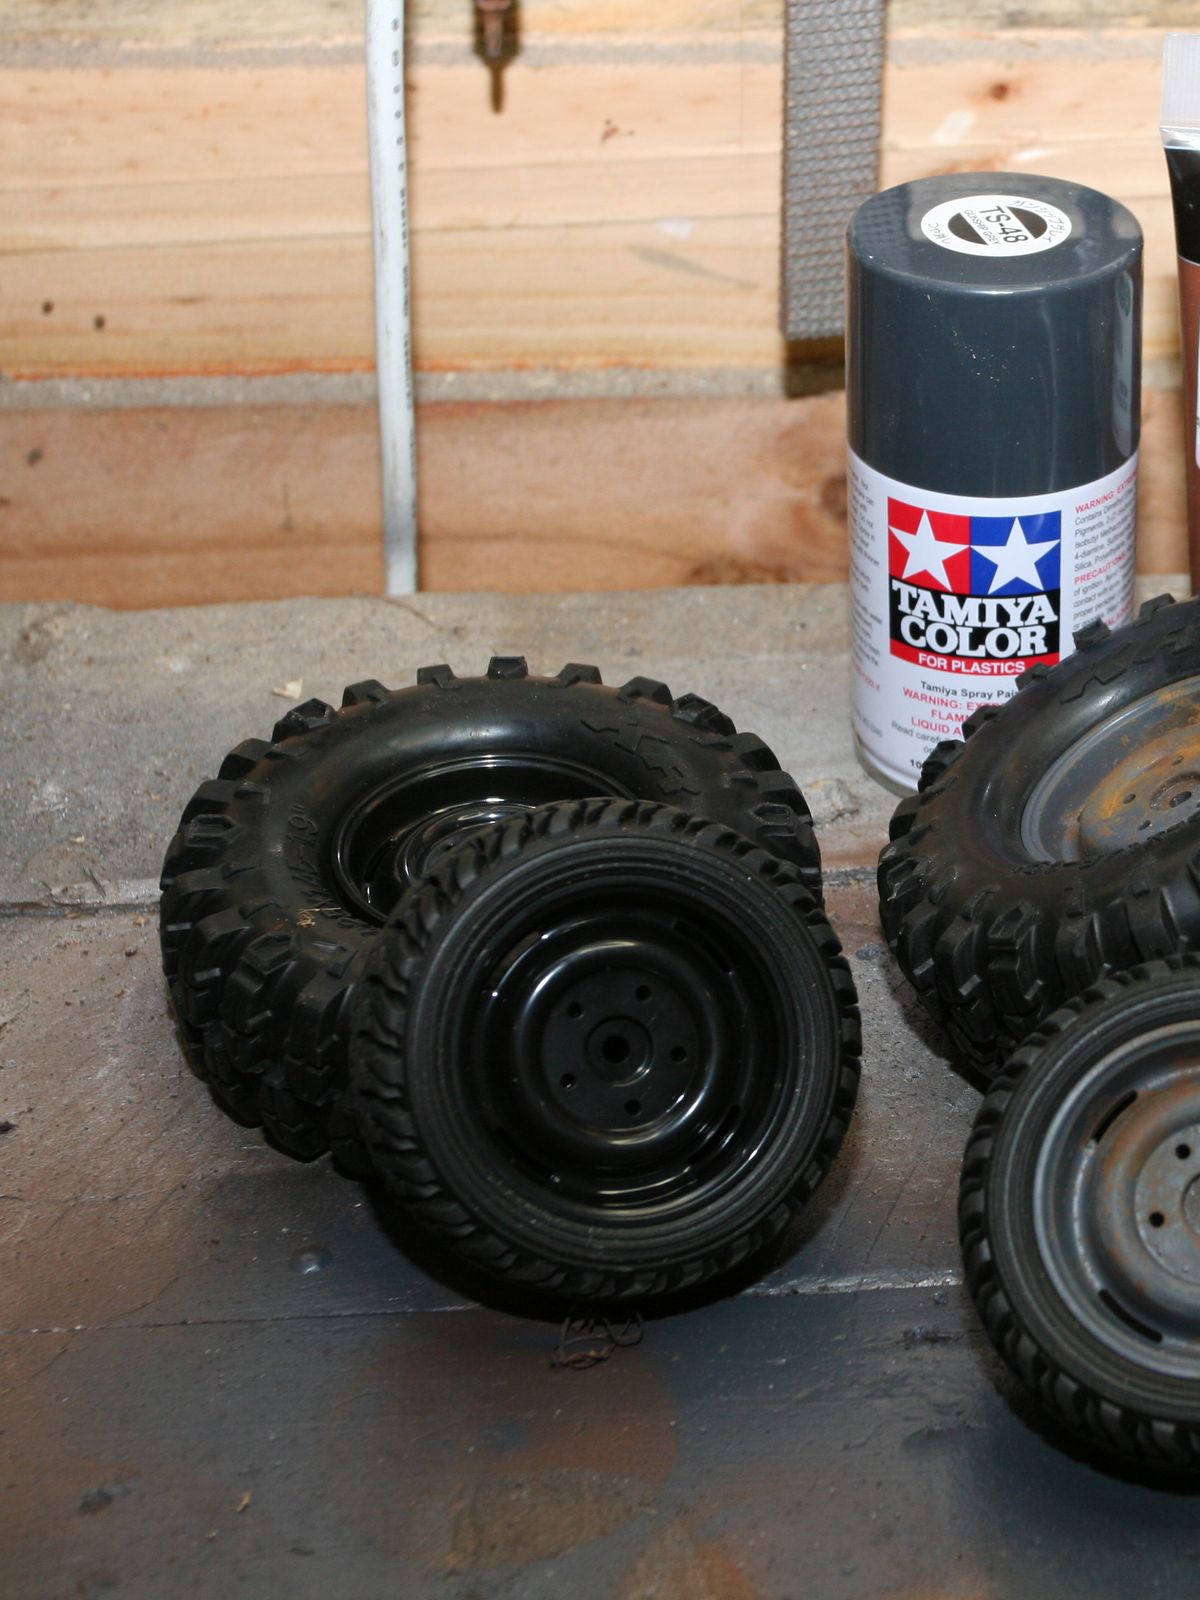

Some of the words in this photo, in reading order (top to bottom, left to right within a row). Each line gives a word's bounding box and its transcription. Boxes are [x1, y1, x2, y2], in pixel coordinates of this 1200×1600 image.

[979, 205, 1028, 244] TS-48
[892, 578, 1058, 628] TAMIYA
[900, 614, 1048, 658] COLOR
[918, 653, 948, 671] FOR
[951, 659, 1026, 674] PLASTICS
[902, 687, 963, 710] WARNING:
[921, 680, 957, 697] Tamiya
[961, 688, 993, 700] Spray
[997, 690, 1018, 698] Pai
[891, 720, 914, 737] Read
[911, 716, 950, 734] LIQUID
